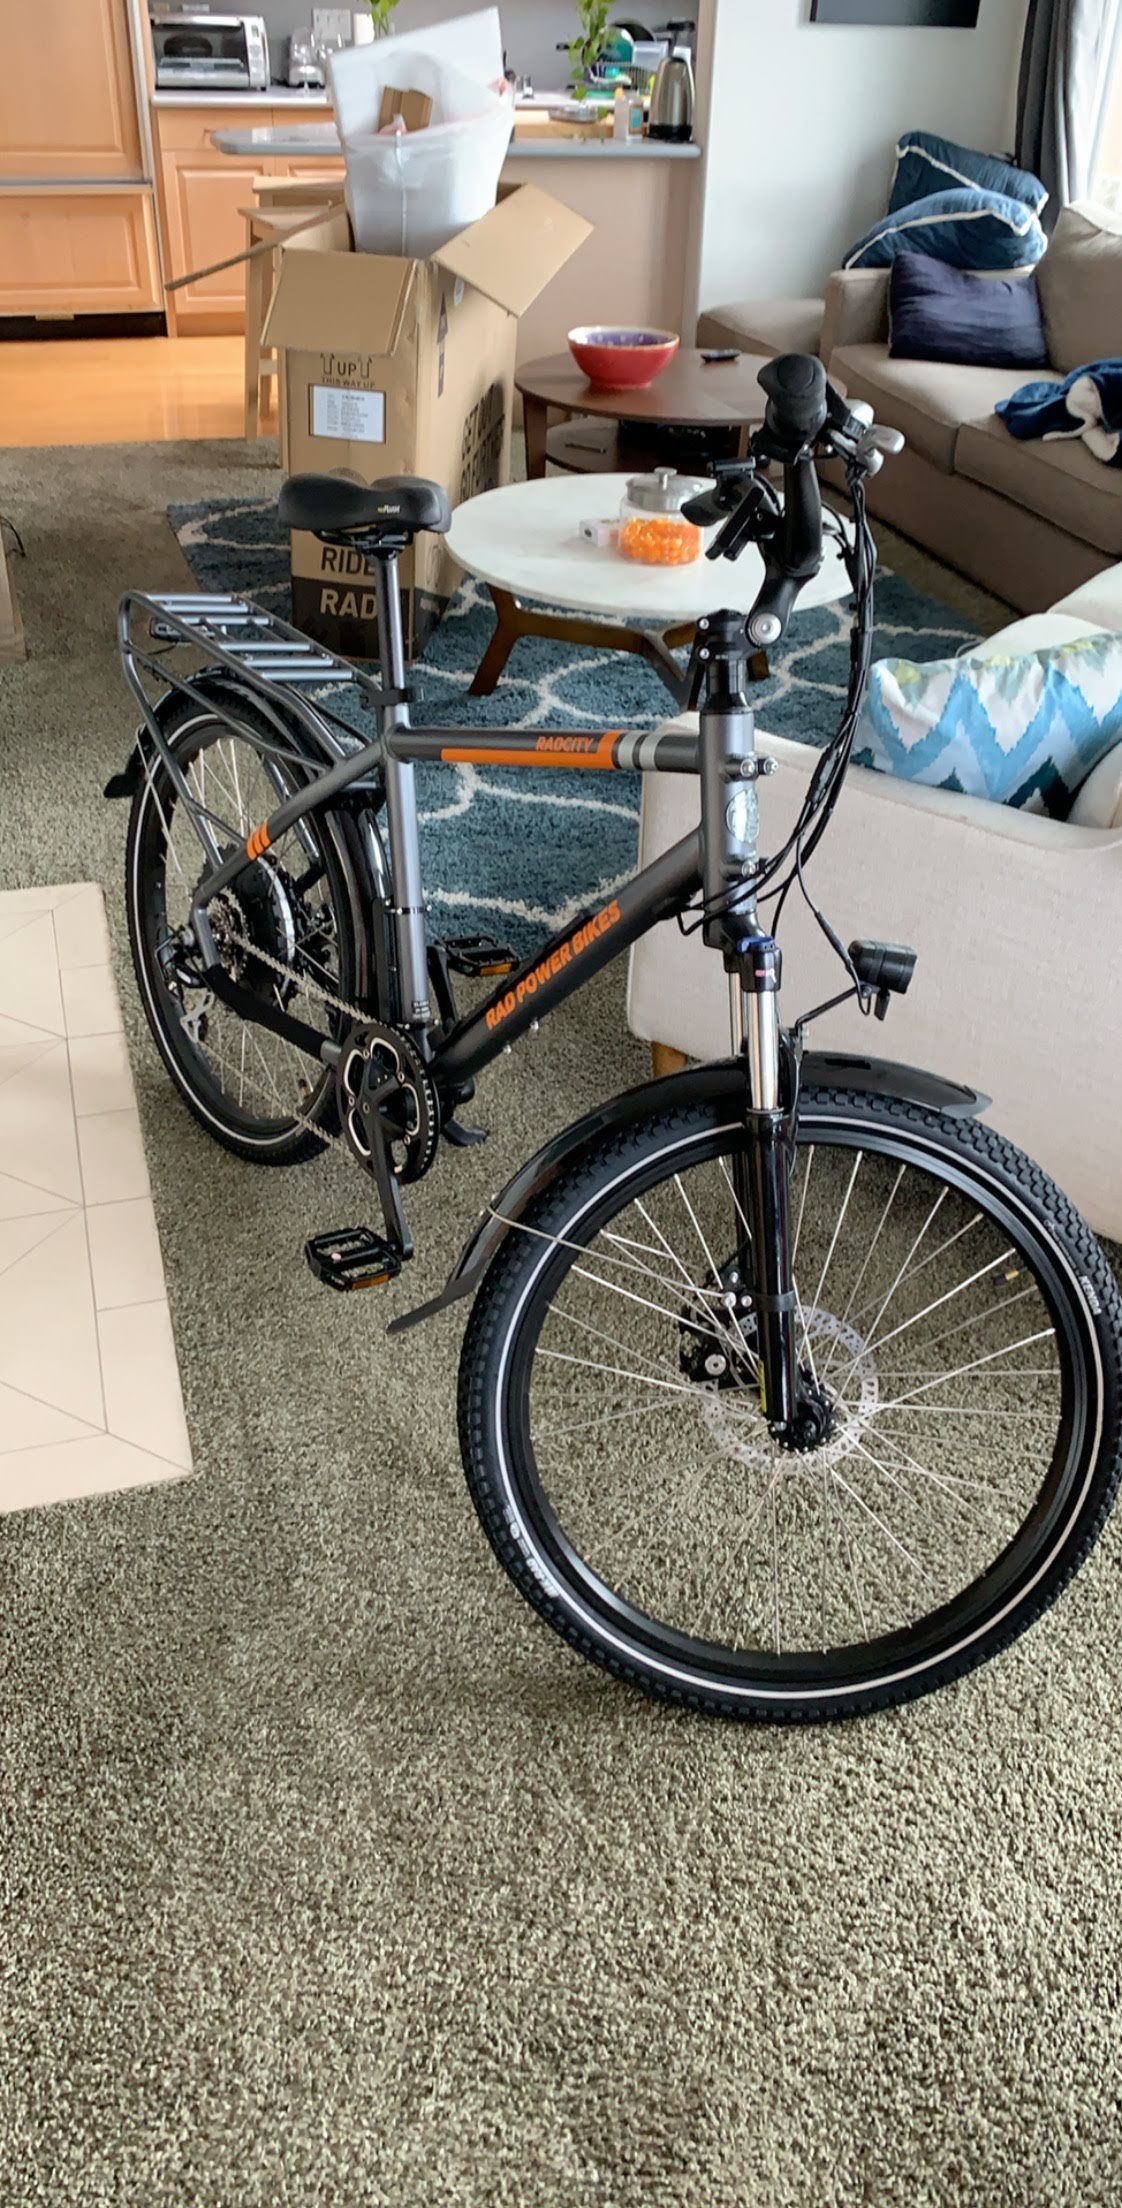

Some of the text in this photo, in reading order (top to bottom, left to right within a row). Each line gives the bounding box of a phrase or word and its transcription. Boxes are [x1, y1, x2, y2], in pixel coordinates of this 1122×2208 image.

[337, 360, 357, 376] UP
[320, 588, 379, 620] RAD
[535, 735, 596, 752] RADCITY
[486, 899, 621, 1030] RAD POWER BIKES
